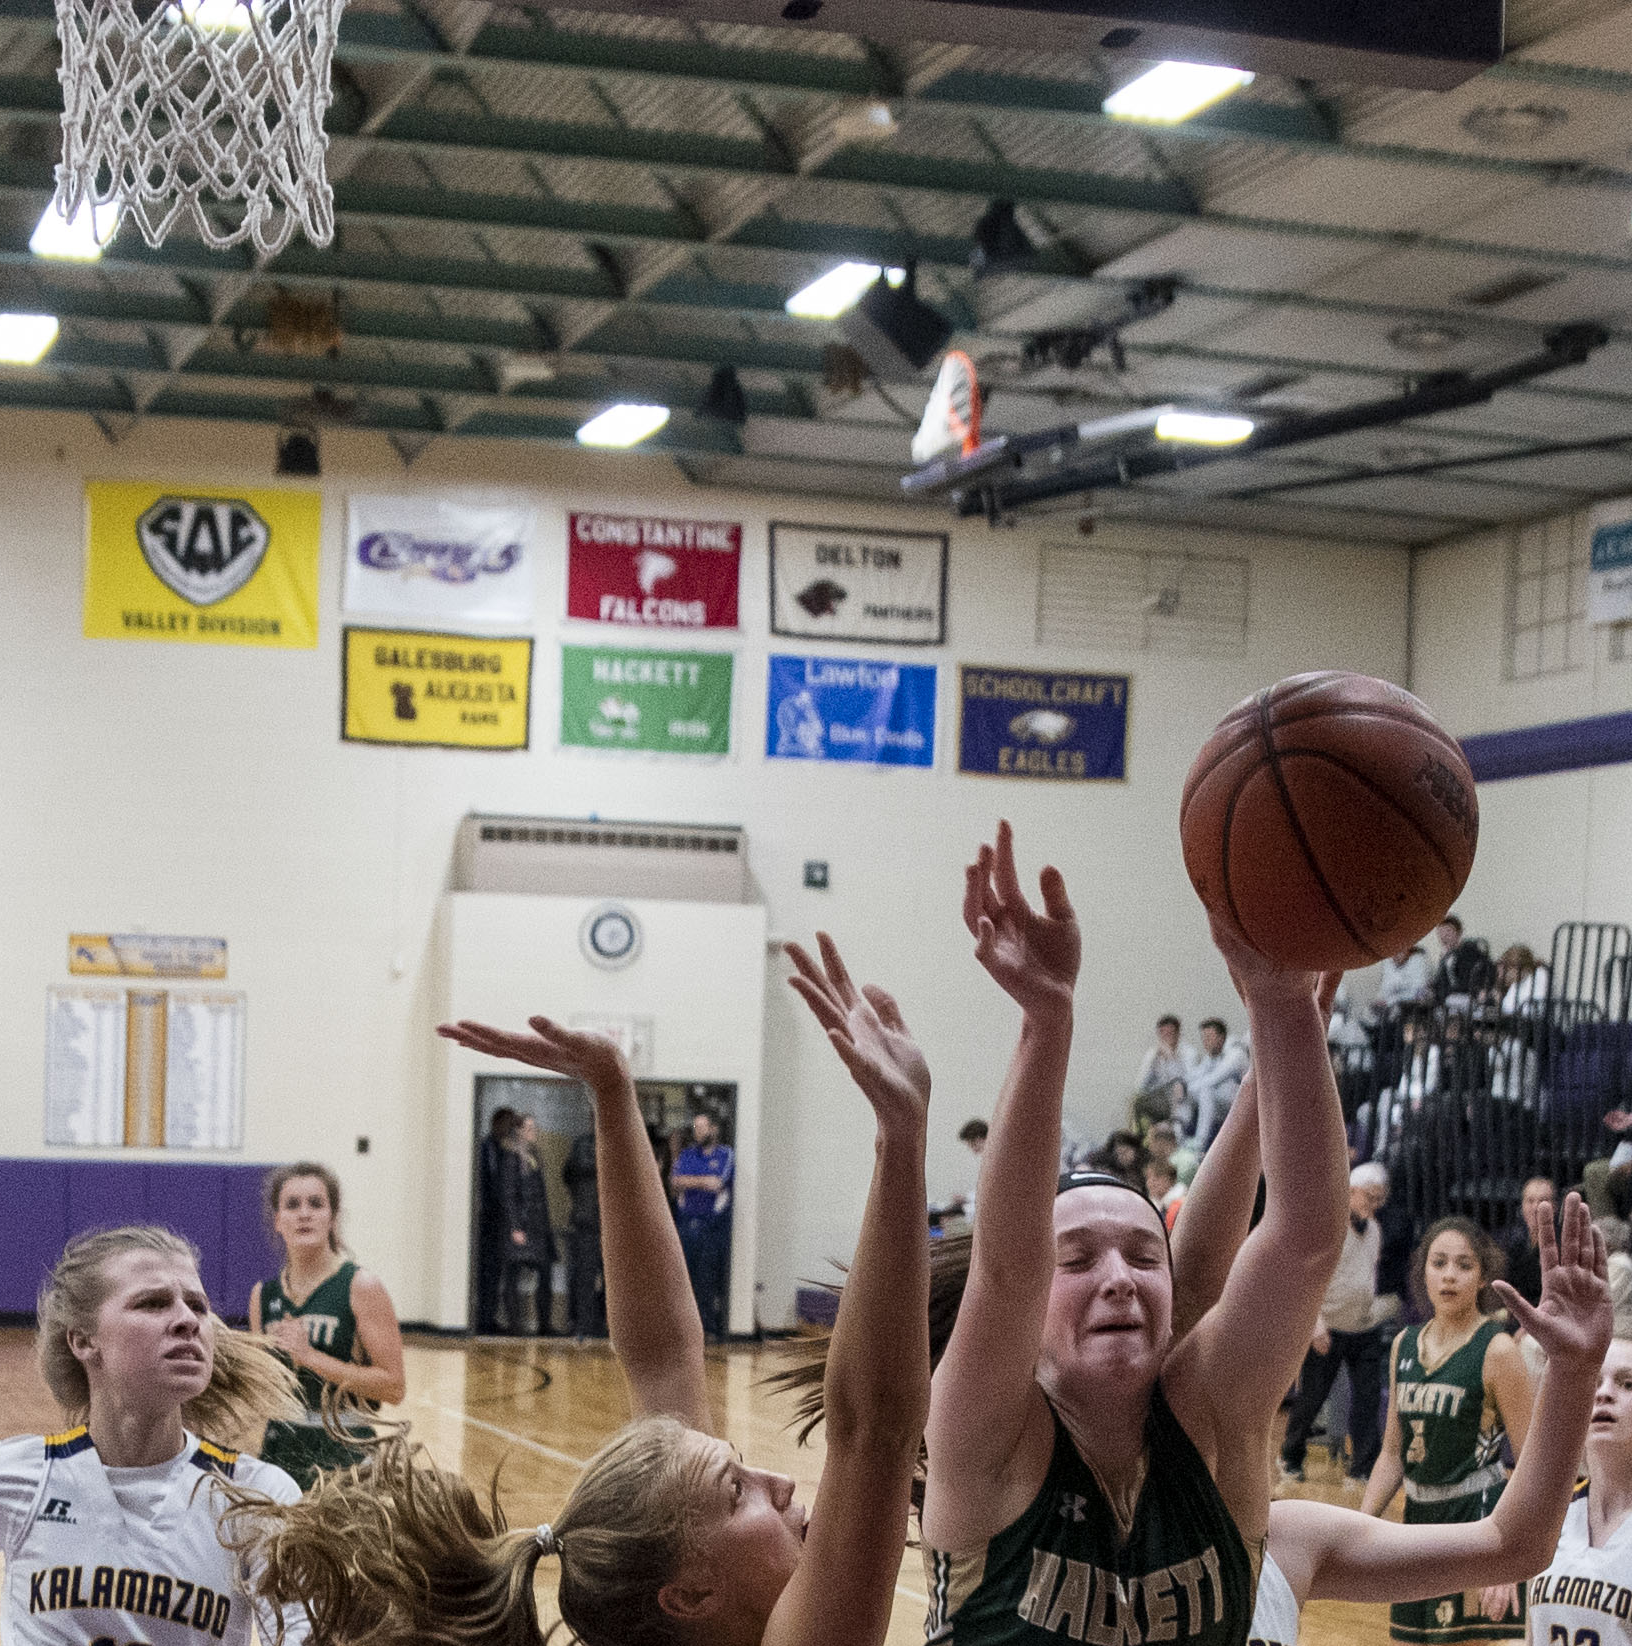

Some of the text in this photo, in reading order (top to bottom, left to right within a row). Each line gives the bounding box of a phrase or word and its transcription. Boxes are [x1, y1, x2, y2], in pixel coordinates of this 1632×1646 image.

[575, 513, 733, 550] CONSTANTINE
[815, 542, 902, 571] DELTON
[122, 609, 283, 639] VALLEY DIVISION
[598, 595, 705, 627] FALCONS
[374, 645, 502, 675] GALESBURG
[592, 656, 702, 690] HACKETT
[964, 673, 1125, 707] SCHOOLCRAFT
[996, 746, 1086, 776] EAGLES
[30, 1565, 232, 1641] KALAMAZOO
